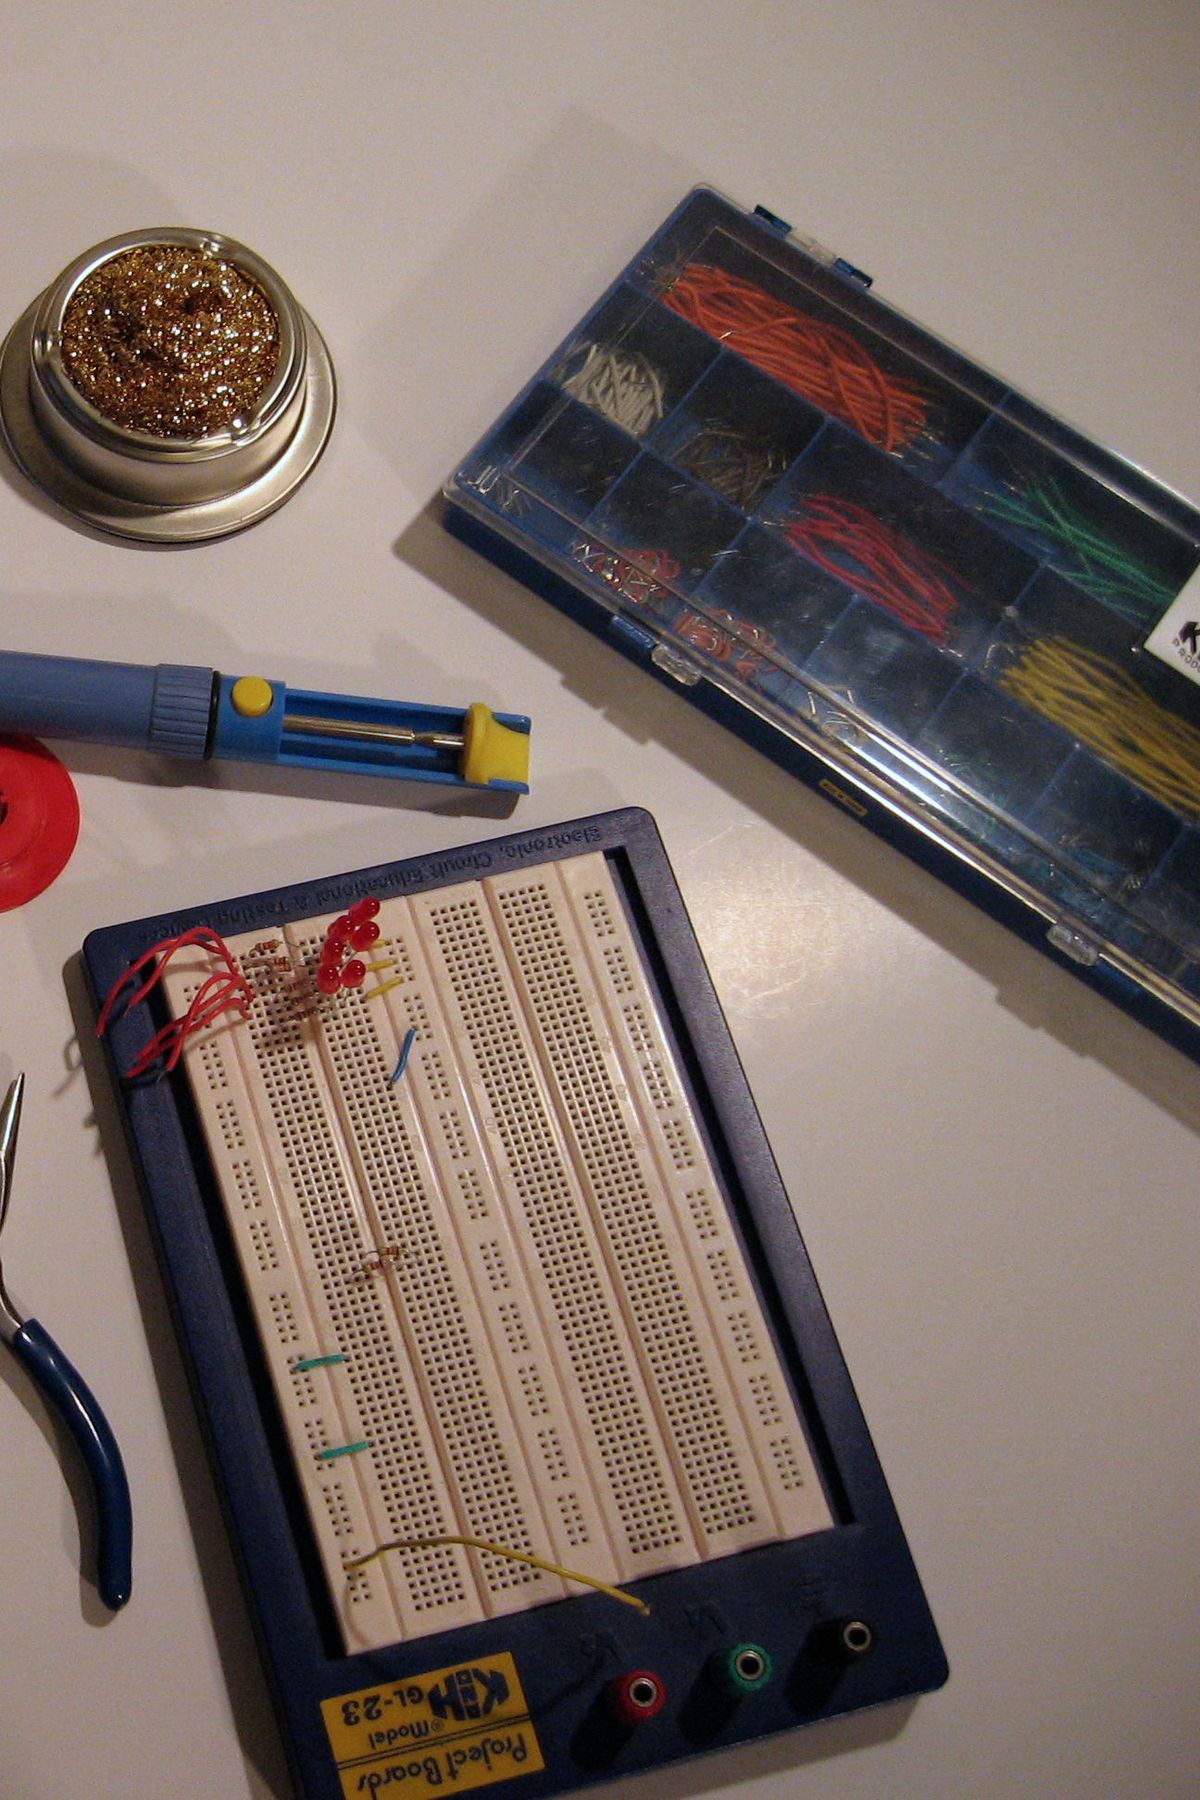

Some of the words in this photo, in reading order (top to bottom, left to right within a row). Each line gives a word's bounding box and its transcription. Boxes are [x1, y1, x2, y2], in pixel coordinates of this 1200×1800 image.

[341, 1684, 425, 1726] GL-23
[368, 1719, 430, 1750] Model
[356, 1756, 444, 1800] Boards
[446, 1732, 528, 1782] Project
